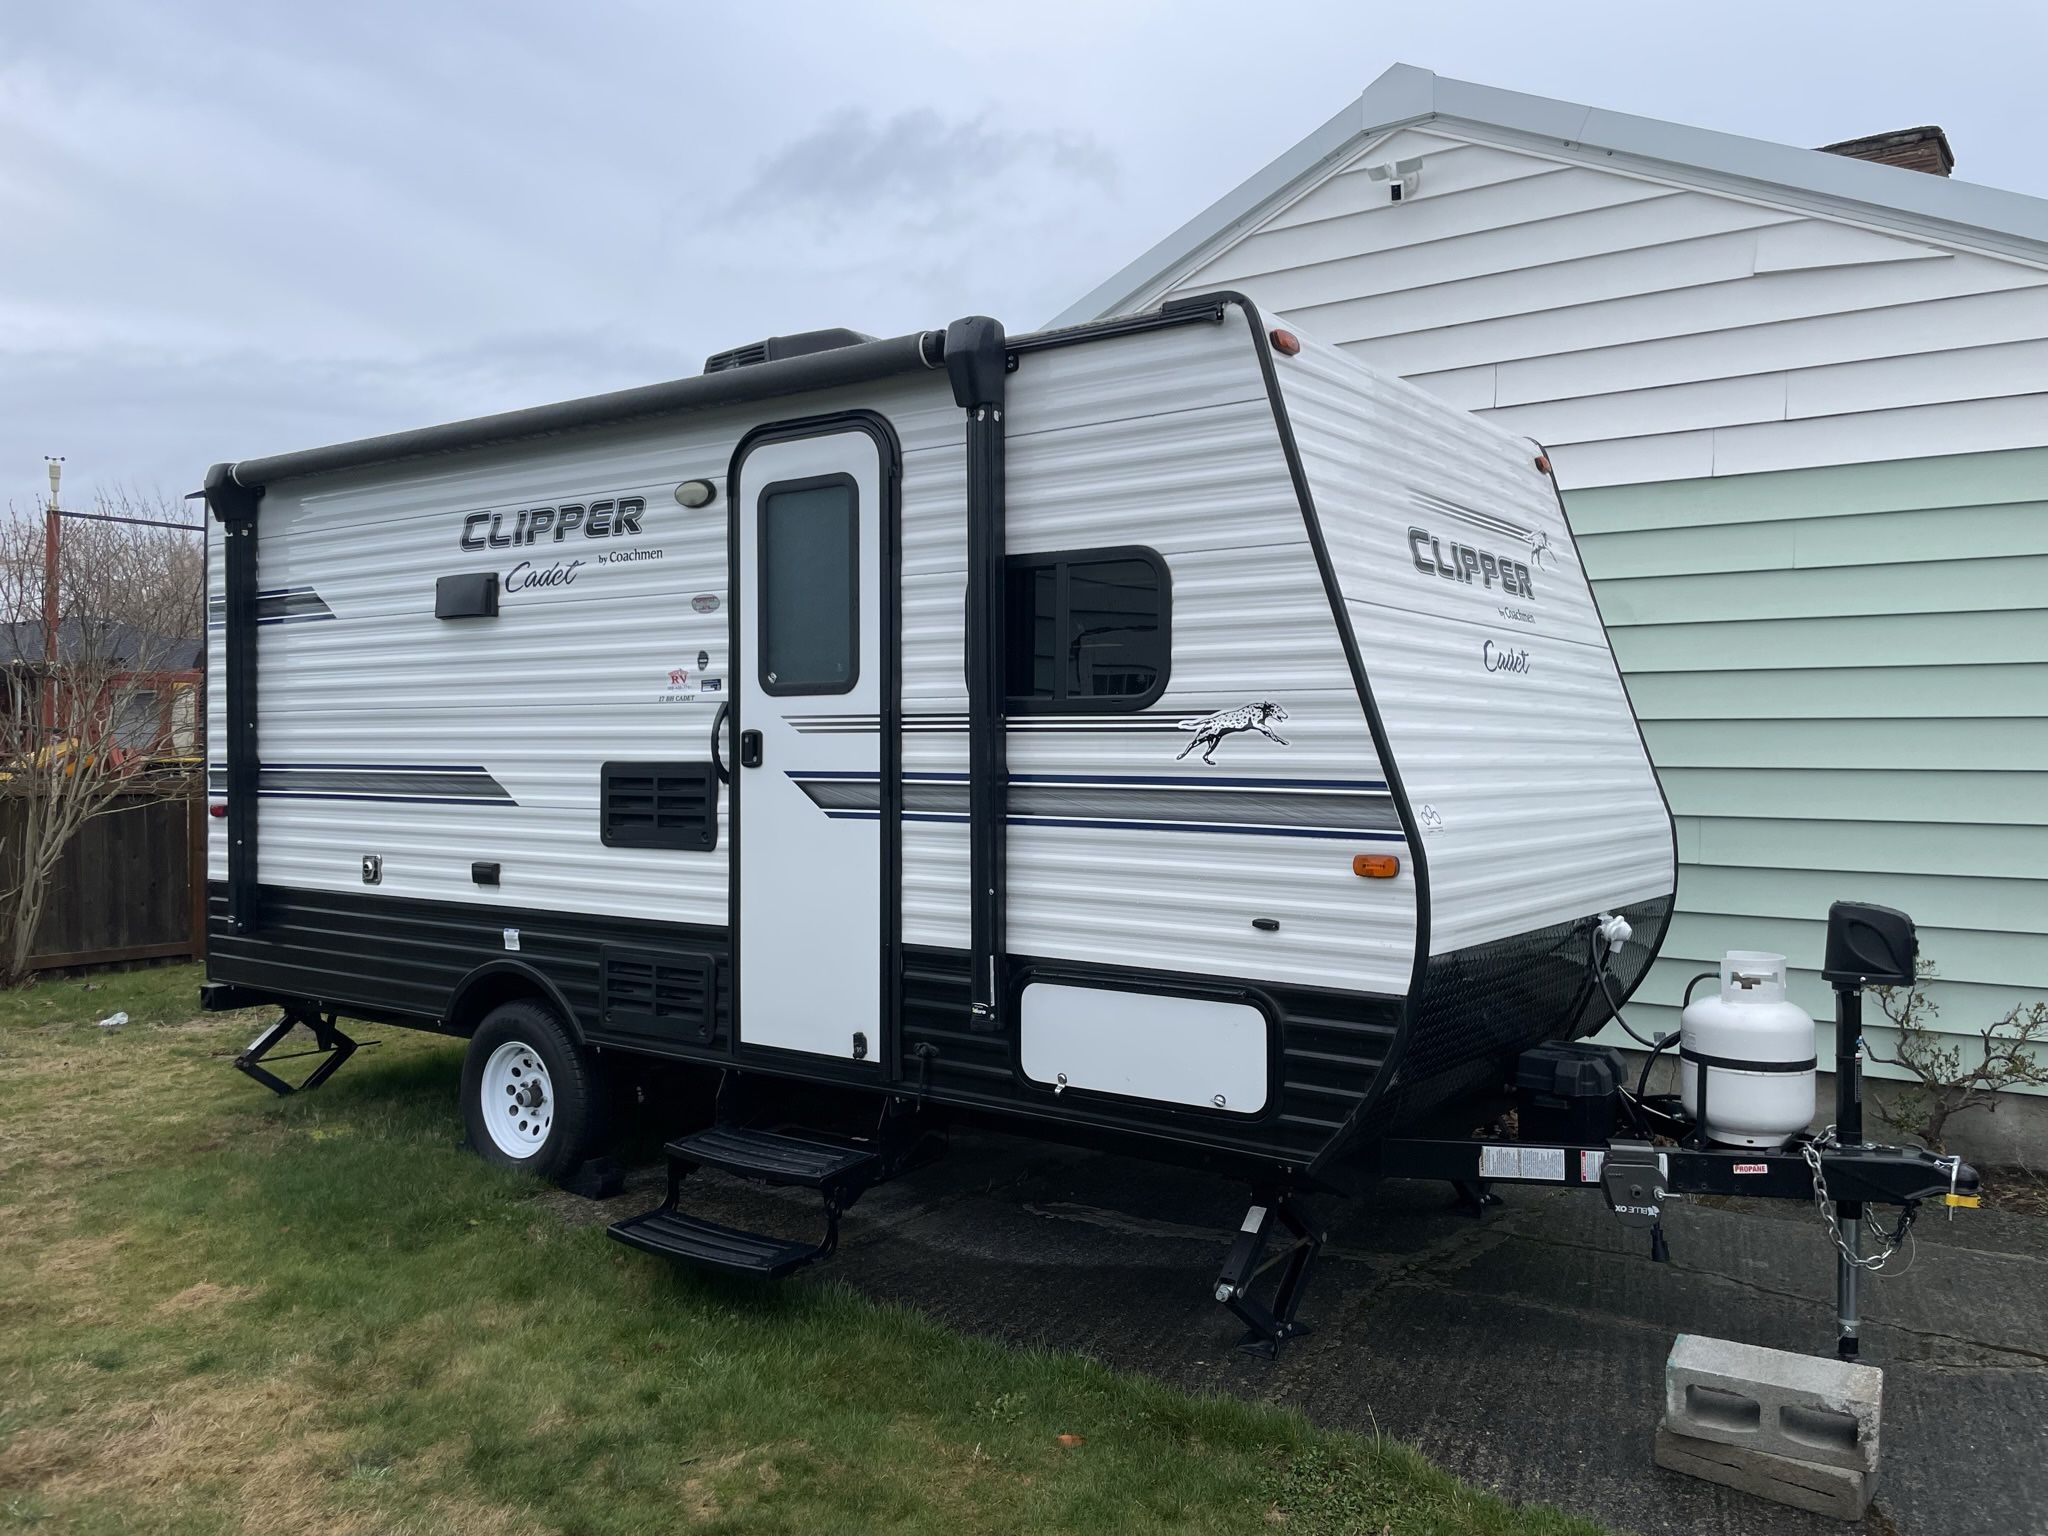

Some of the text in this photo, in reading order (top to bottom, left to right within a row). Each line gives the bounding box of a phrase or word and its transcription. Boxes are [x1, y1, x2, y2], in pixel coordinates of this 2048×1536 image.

[460, 496, 646, 552] CLIPPER
[598, 547, 663, 566] by Coachmen
[1408, 526, 1535, 600] CLIPPER
[505, 560, 586, 593] Cadet
[1483, 639, 1531, 674] Cadet
[1614, 1204, 1649, 1215] BLUE OX
